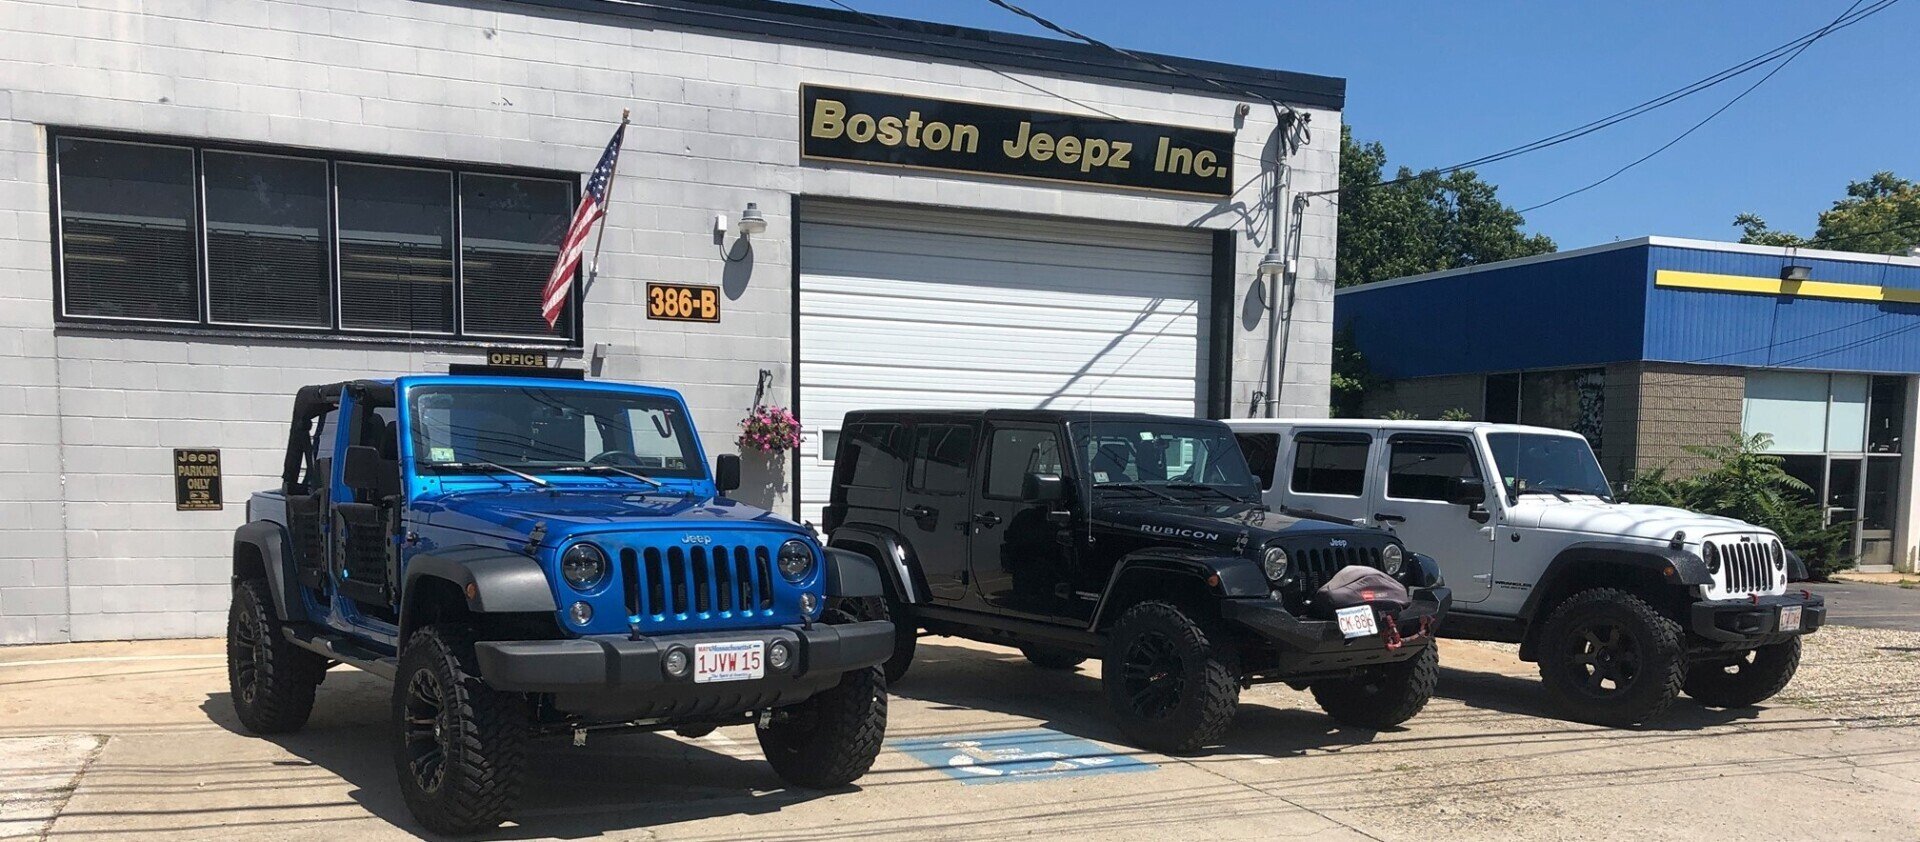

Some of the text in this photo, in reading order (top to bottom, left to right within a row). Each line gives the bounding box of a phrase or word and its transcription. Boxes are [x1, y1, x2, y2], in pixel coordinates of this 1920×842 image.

[811, 98, 1228, 179] Boston Jeepz Inc.
[650, 286, 716, 319] 386-B
[491, 353, 544, 366] OFFICE
[178, 451, 217, 464] Jeep
[178, 465, 218, 476] PARKING
[187, 478, 210, 489] ONLY
[681, 533, 712, 545] Jeep
[1140, 524, 1219, 541] RUBICON
[1329, 538, 1348, 548] Jeep
[698, 651, 761, 674] 1JVW 15
